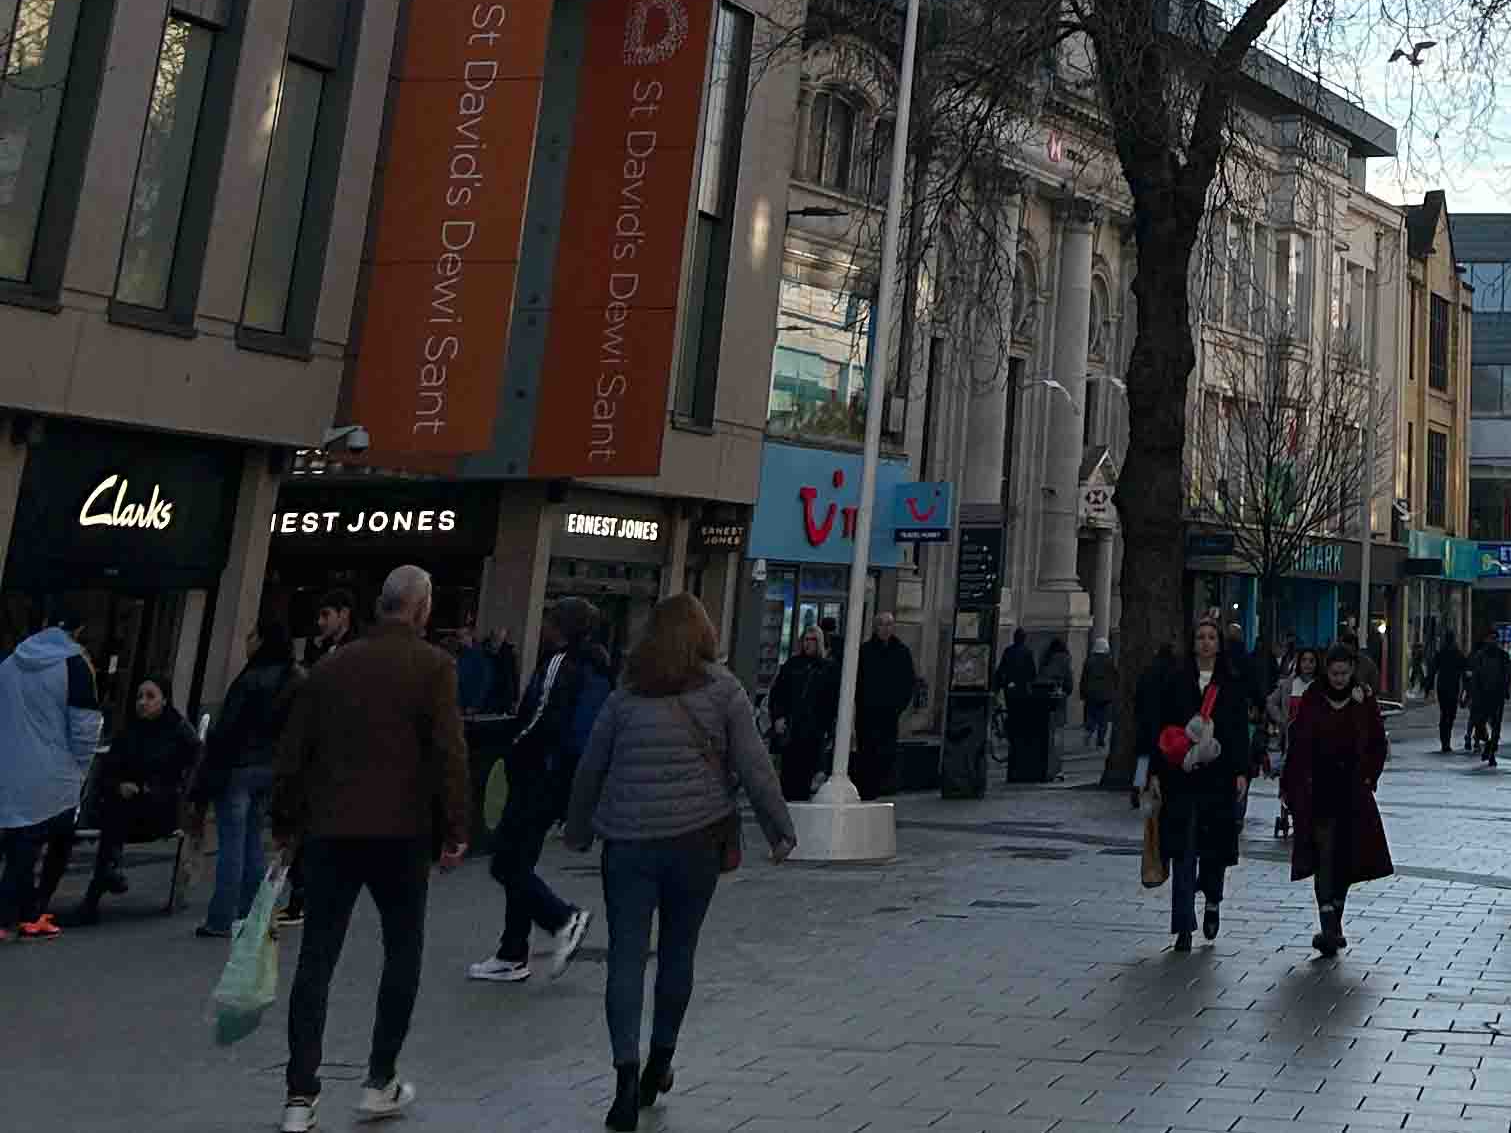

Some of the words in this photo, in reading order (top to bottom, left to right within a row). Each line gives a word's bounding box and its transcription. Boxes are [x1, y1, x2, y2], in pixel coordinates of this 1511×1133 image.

[465, 2, 506, 47] St
[445, 60, 500, 207] David's
[630, 80, 664, 119] St
[613, 130, 656, 259] David's
[423, 220, 476, 324] Dewi
[600, 273, 640, 363] Dewi
[413, 335, 460, 435] Sant
[590, 373, 627, 464] Sant
[79, 474, 174, 530] Clarks
[347, 509, 456, 532] JONES
[567, 513, 617, 537] ERNEST
[618, 519, 659, 541] JONES
